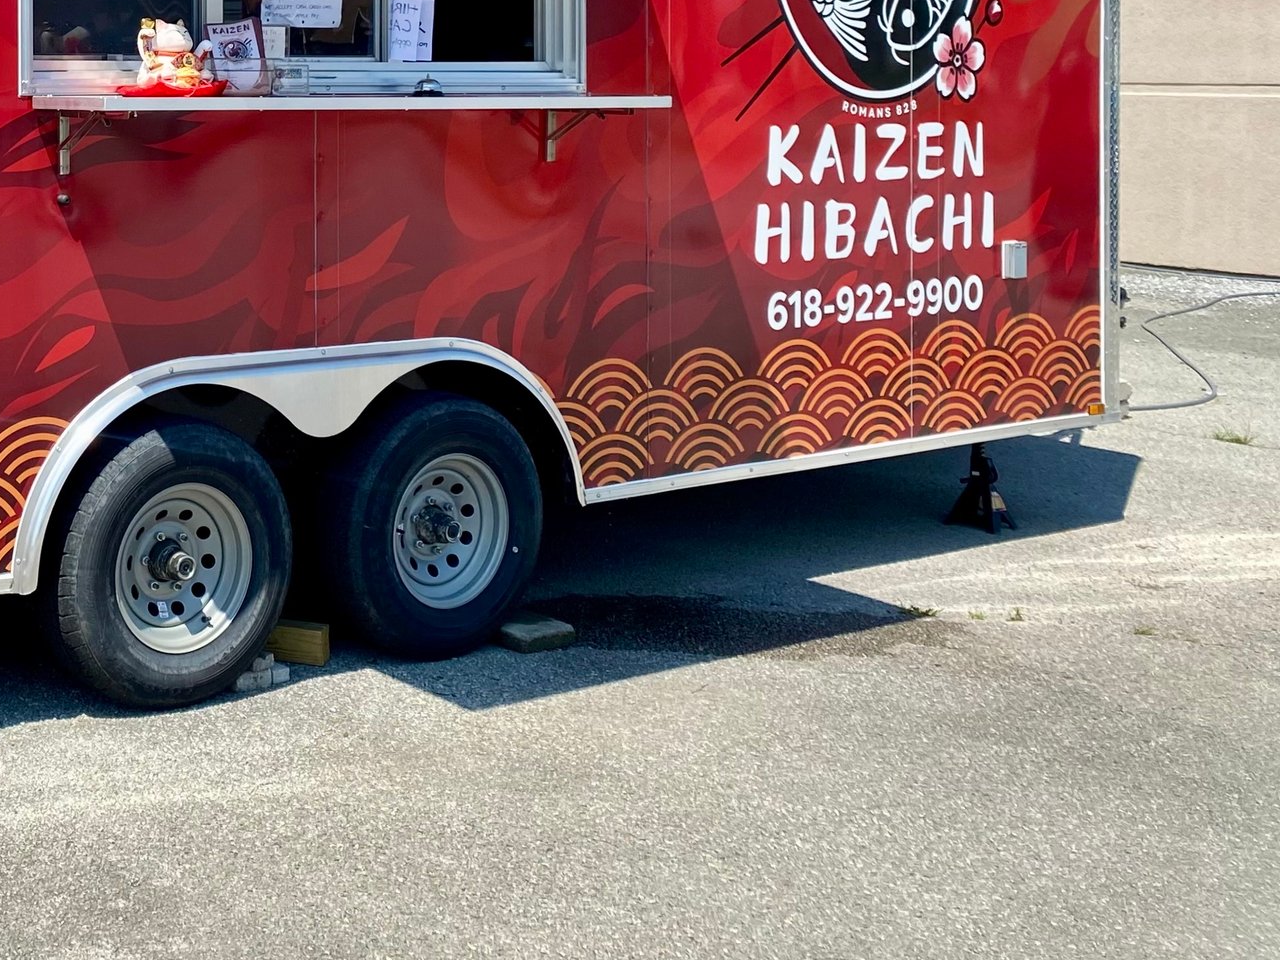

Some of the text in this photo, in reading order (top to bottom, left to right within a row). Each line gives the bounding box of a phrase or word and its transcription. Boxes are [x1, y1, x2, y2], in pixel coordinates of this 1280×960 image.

[212, 24, 250, 34] KAIZEN
[842, 100, 892, 118] ROMANS
[767, 120, 984, 186] KAIZEN
[754, 191, 994, 264] HIBACHI
[768, 274, 983, 330] 618-922-9900
